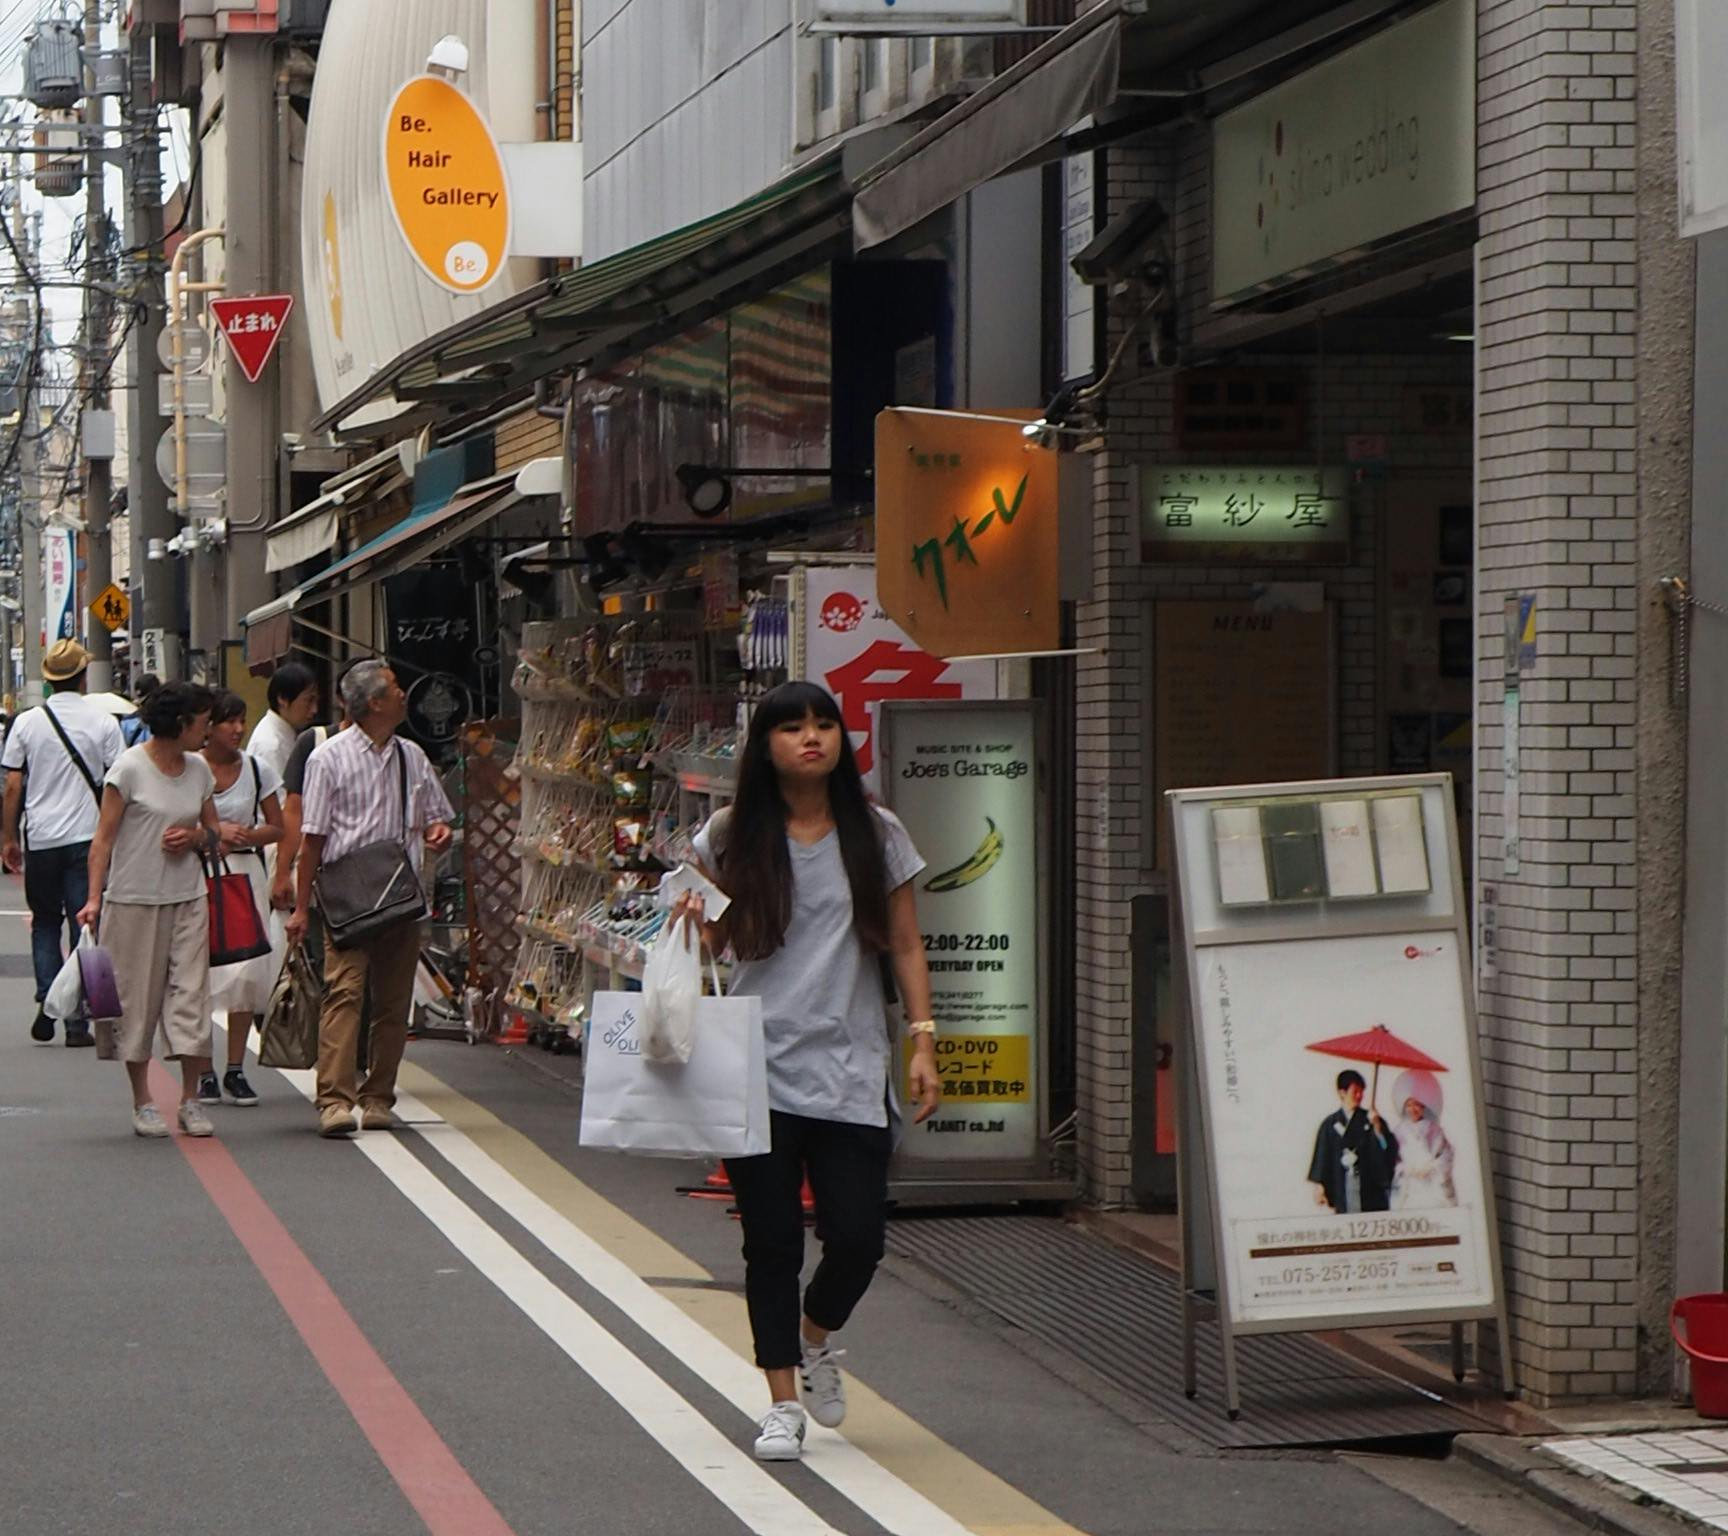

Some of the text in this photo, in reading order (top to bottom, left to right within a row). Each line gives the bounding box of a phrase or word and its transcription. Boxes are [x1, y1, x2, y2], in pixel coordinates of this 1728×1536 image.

[400, 115, 433, 134] Be.
[408, 150, 452, 168] Hair
[422, 188, 500, 209] Gallery
[227, 311, 278, 334] 止まれ
[1159, 492, 1329, 529] 富紗屋
[1212, 615, 1274, 632] MENU
[916, 745, 948, 754] MUSIC
[951, 745, 973, 754] SITE
[985, 745, 1013, 754] SHOP
[954, 759, 1029, 779] Garage
[926, 960, 1005, 972] VERYDAY OPEN
[603, 1007, 636, 1045] OLIVE
[936, 1060, 993, 1075] レコード
[942, 1080, 1025, 1096] 高価買取中
[927, 1120, 967, 1134] PLANET
[1282, 1261, 1399, 1285] 075-257-2057
